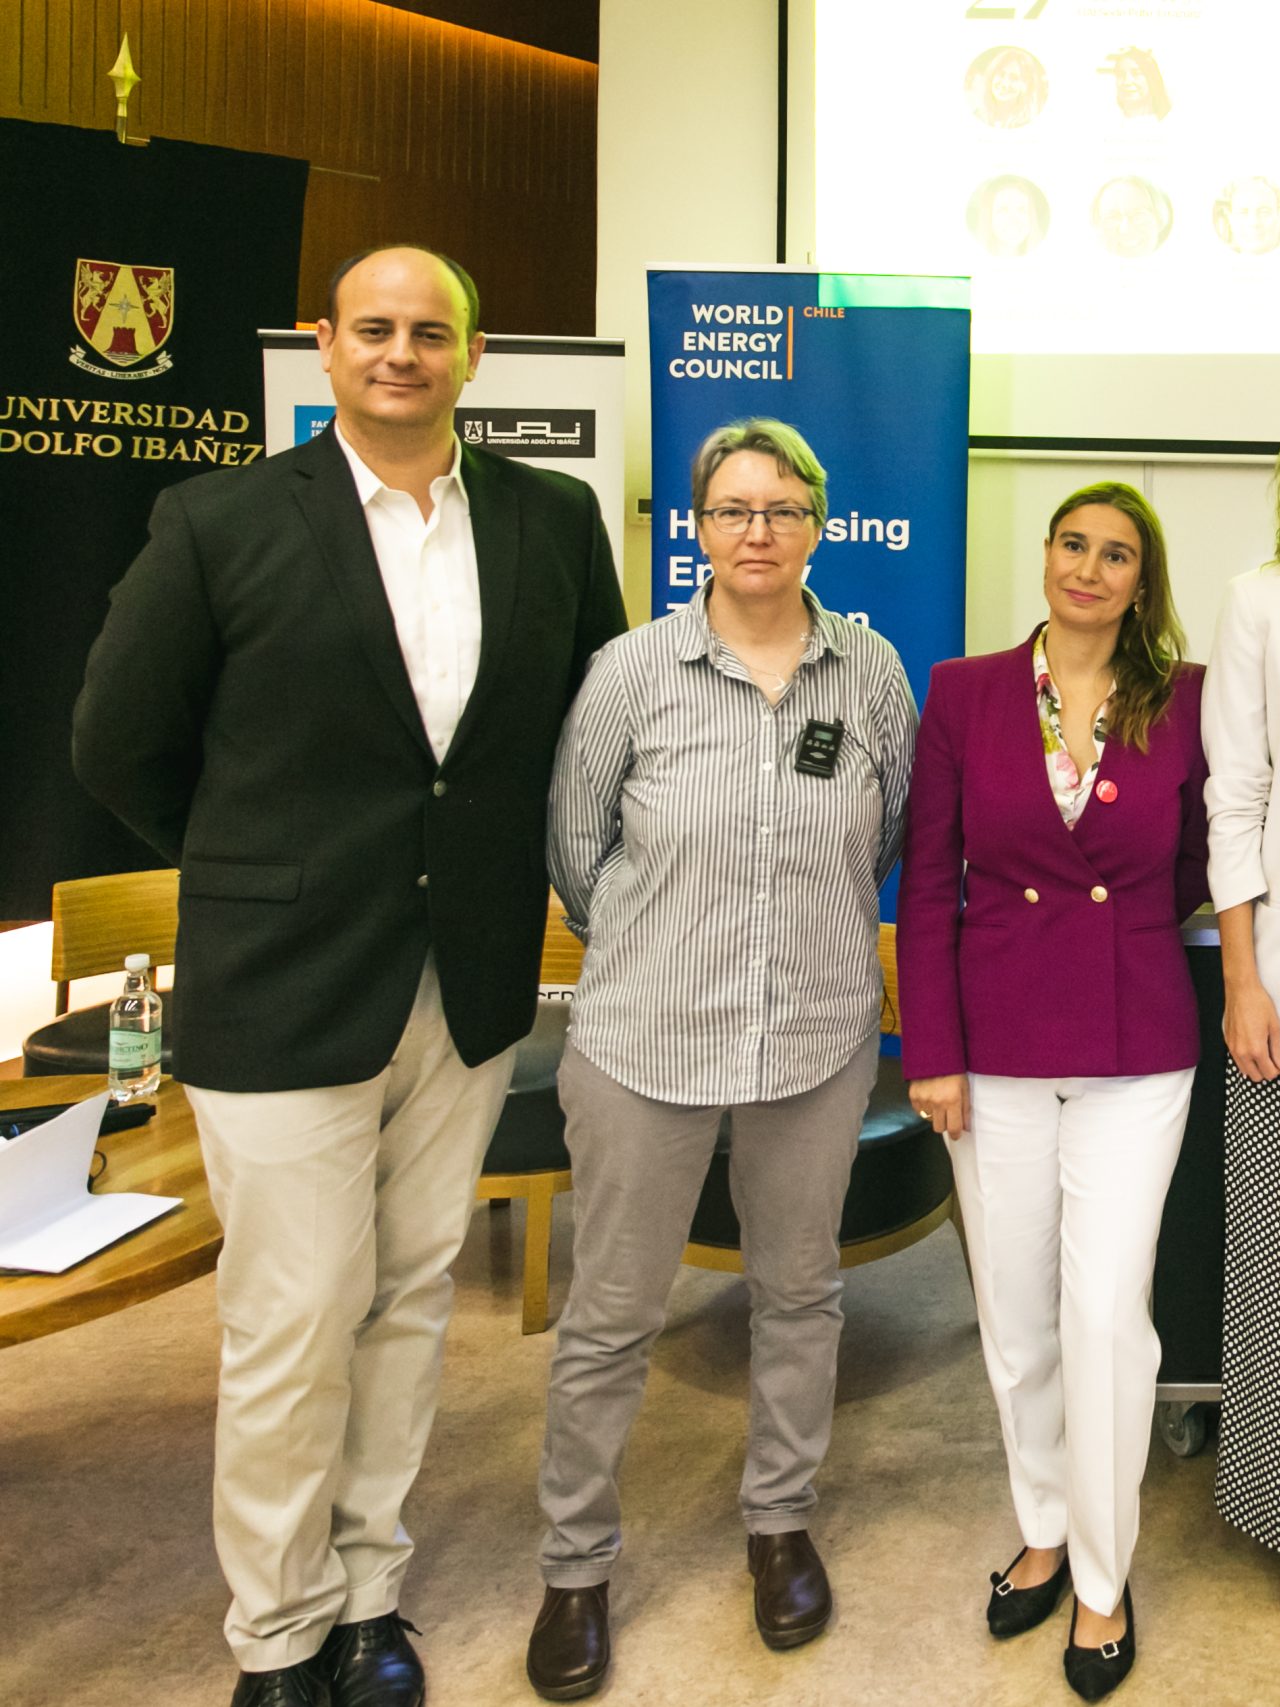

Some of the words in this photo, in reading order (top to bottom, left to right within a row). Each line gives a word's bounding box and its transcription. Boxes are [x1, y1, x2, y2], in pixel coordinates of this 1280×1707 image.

[692, 304, 783, 325] WORLD
[803, 306, 845, 319] CHILE
[683, 332, 783, 353] ENERGY
[669, 358, 783, 380] COUNCIL
[0, 428, 123, 458] DOLFO
[131, 436, 264, 465] IBAÑEZ
